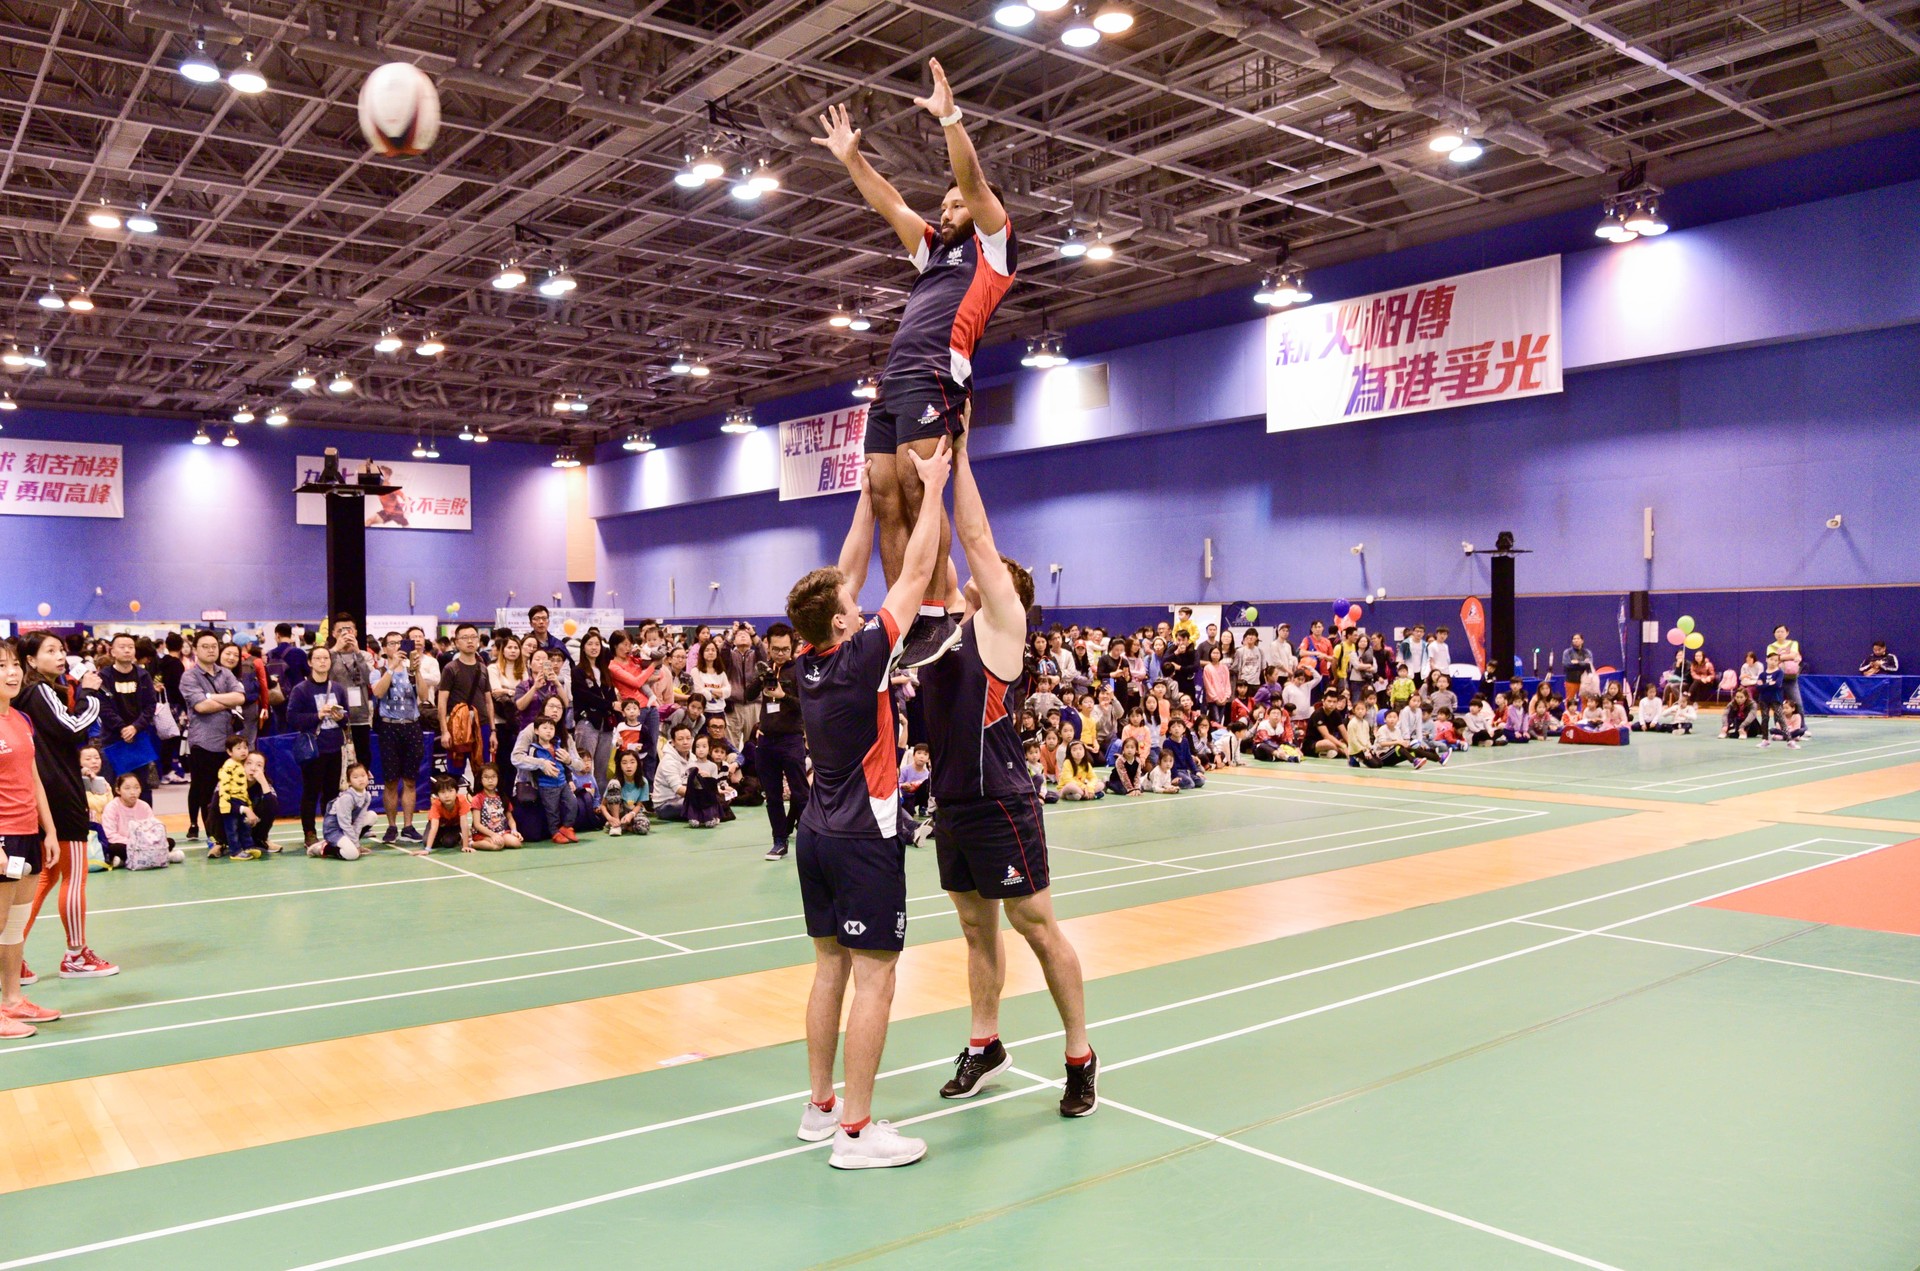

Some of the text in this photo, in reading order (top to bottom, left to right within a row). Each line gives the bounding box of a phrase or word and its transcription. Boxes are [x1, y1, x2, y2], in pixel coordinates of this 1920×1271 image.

[1344, 334, 1550, 416] 為港爭光
[24, 453, 119, 478] 刻苦耐勞
[15, 481, 111, 504] 勇闖高峰
